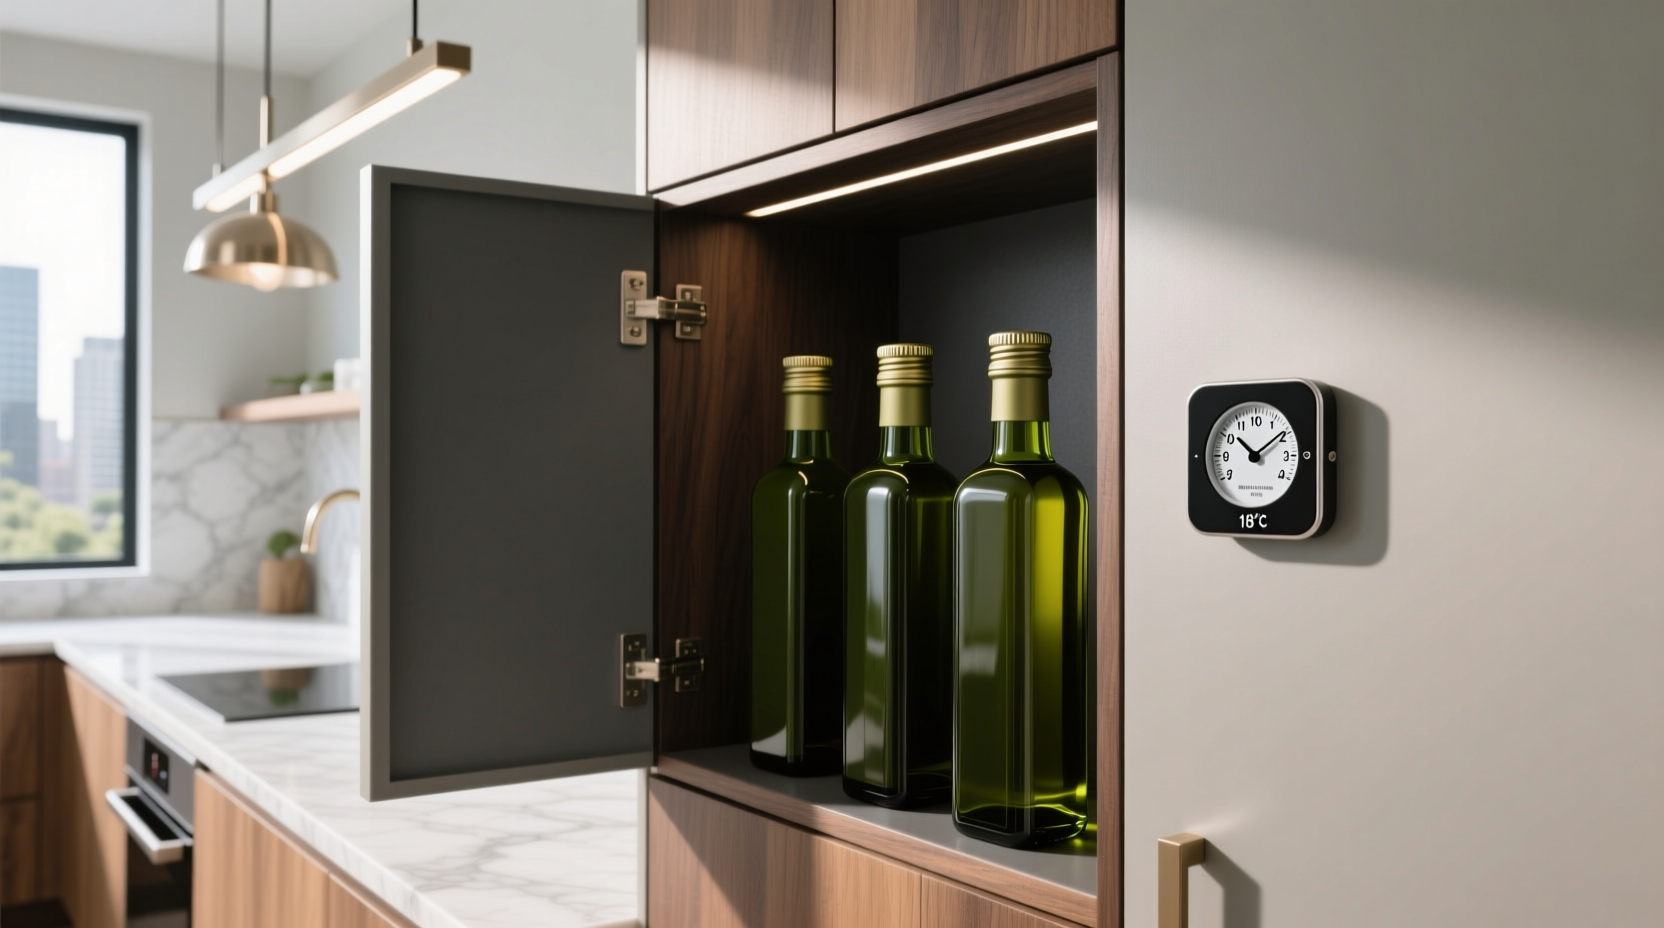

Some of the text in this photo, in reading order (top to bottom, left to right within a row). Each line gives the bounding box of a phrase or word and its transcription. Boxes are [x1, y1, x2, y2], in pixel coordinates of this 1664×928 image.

[1237, 421, 1245, 431] 11
[1251, 416, 1262, 427] 10
[1270, 421, 1274, 429] 1
[1279, 431, 1287, 442] 2
